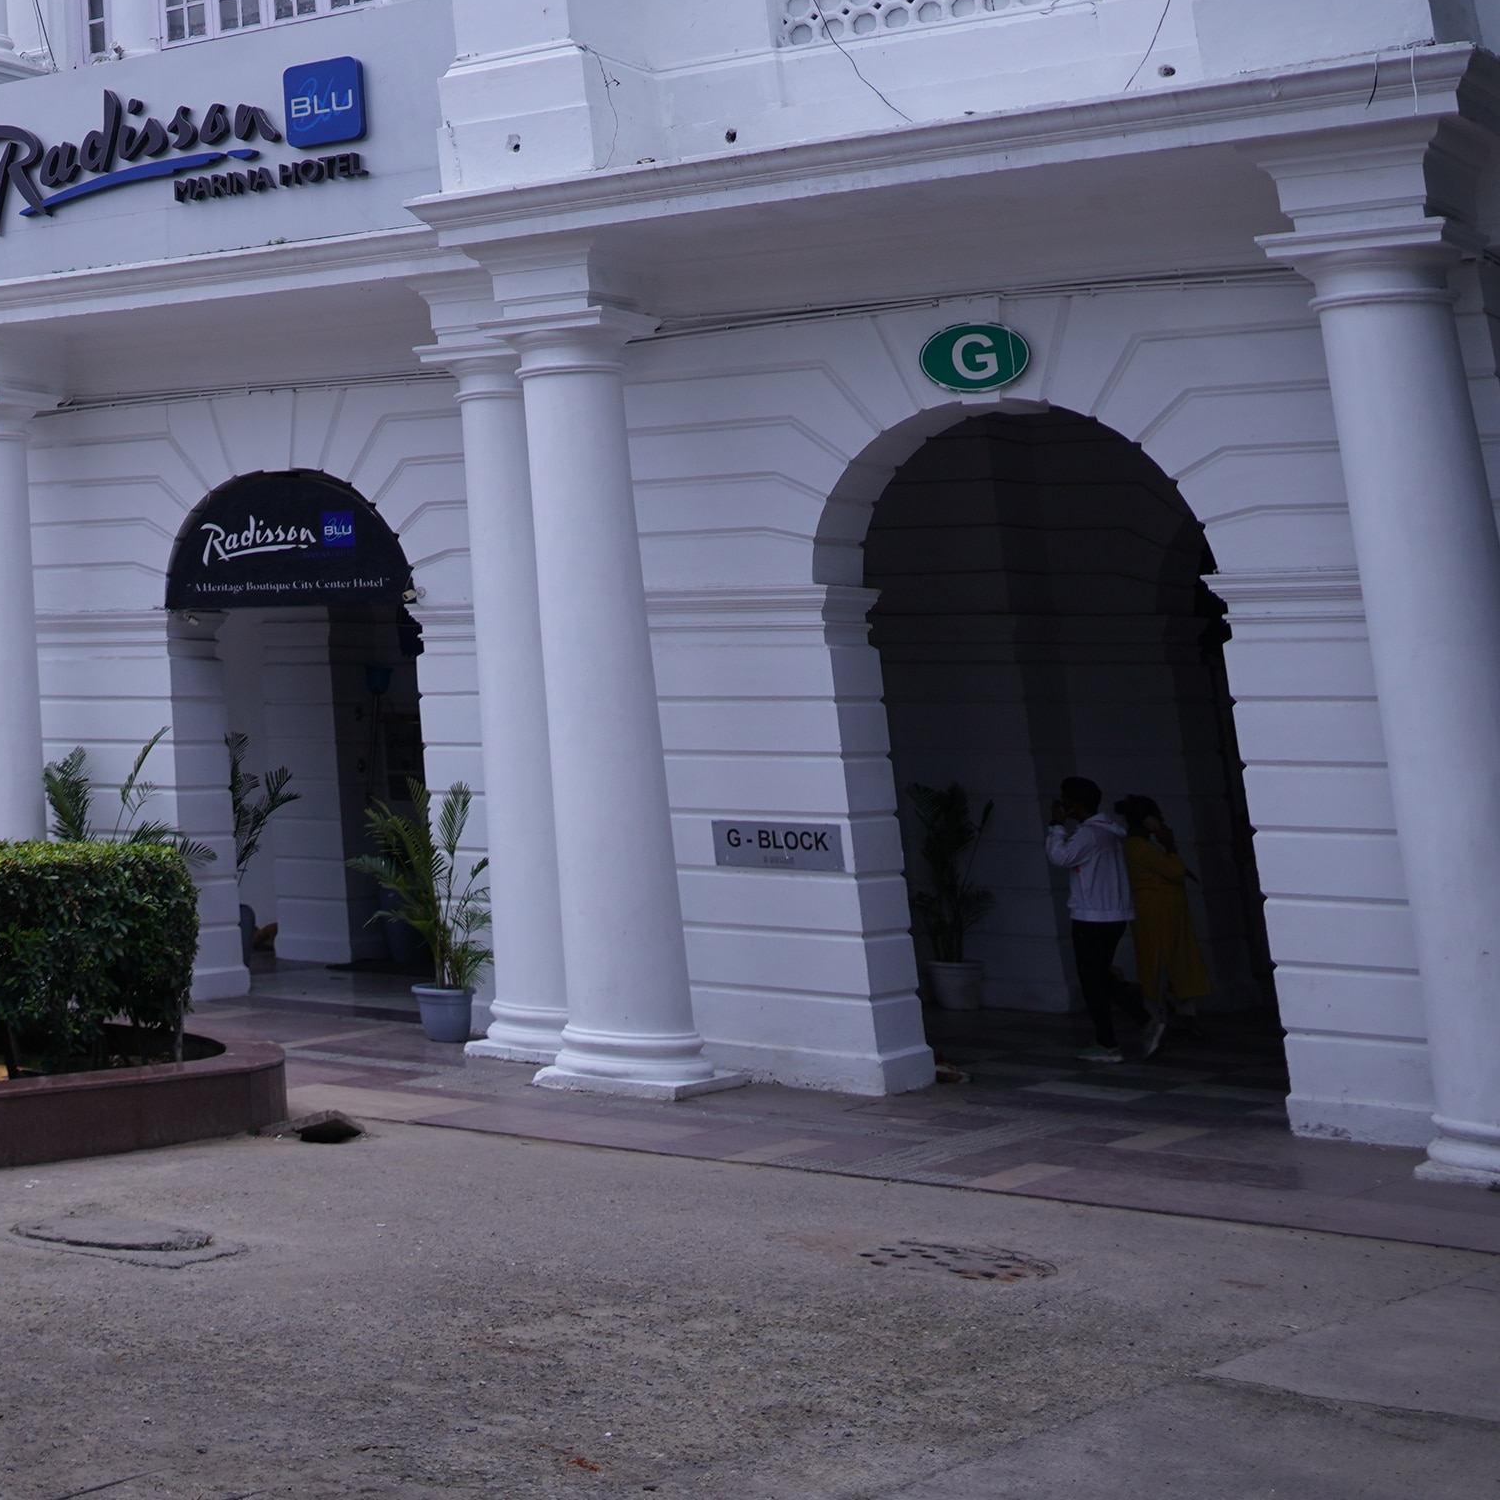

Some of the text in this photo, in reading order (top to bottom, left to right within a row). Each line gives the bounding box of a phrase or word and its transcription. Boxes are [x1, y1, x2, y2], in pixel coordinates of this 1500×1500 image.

[290, 88, 353, 119] BLU
[173, 151, 370, 203] MARINA HOTEL
[952, 333, 999, 380] G
[200, 514, 353, 567] Radisson BLU
[202, 582, 245, 594] Heritage
[246, 580, 291, 593] Boutique
[292, 579, 313, 591] City
[315, 578, 351, 590] Center
[757, 829, 830, 852] BLOCK
